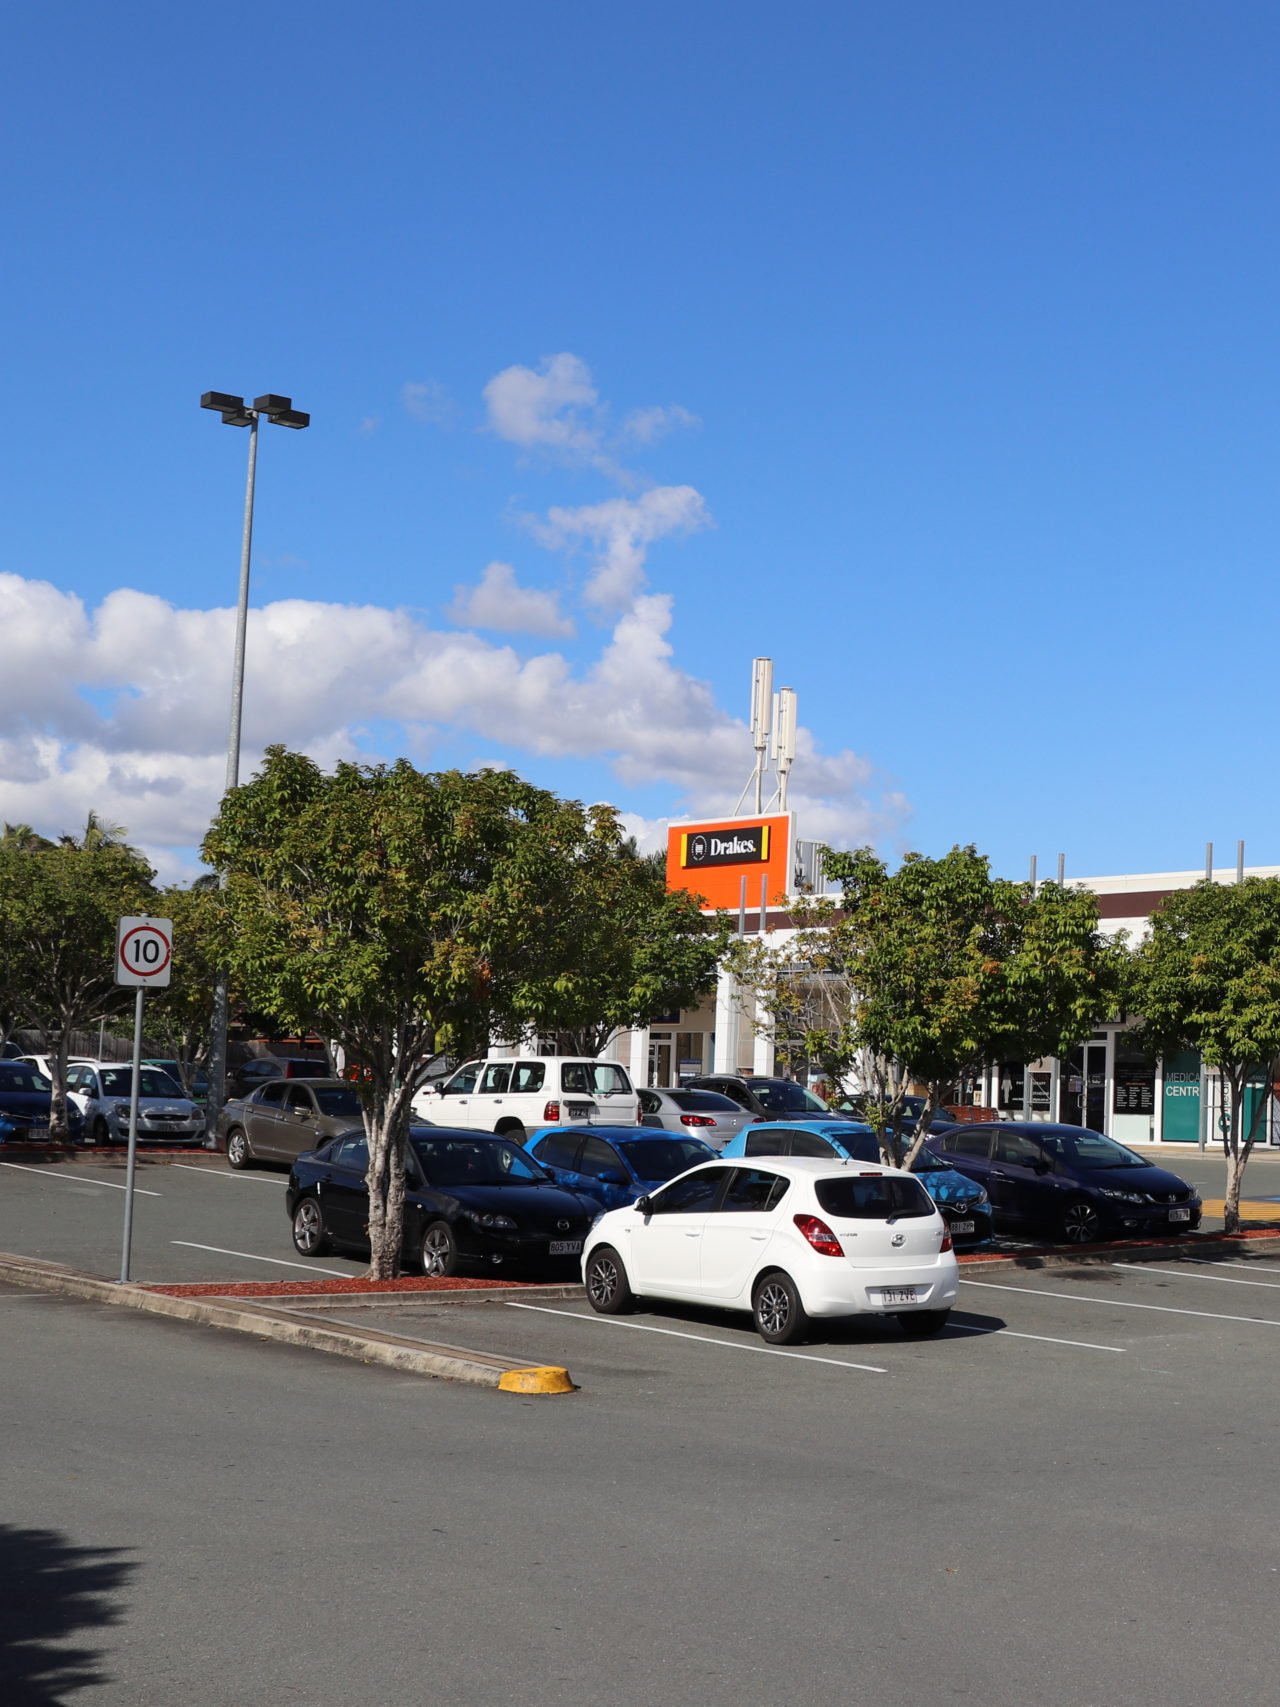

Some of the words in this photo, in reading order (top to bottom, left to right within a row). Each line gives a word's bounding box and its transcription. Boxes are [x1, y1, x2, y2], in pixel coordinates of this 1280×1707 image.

[133, 938, 160, 964] 10
[1166, 1072, 1200, 1083] MEDICA
[1165, 1085, 1200, 1097] CENTR
